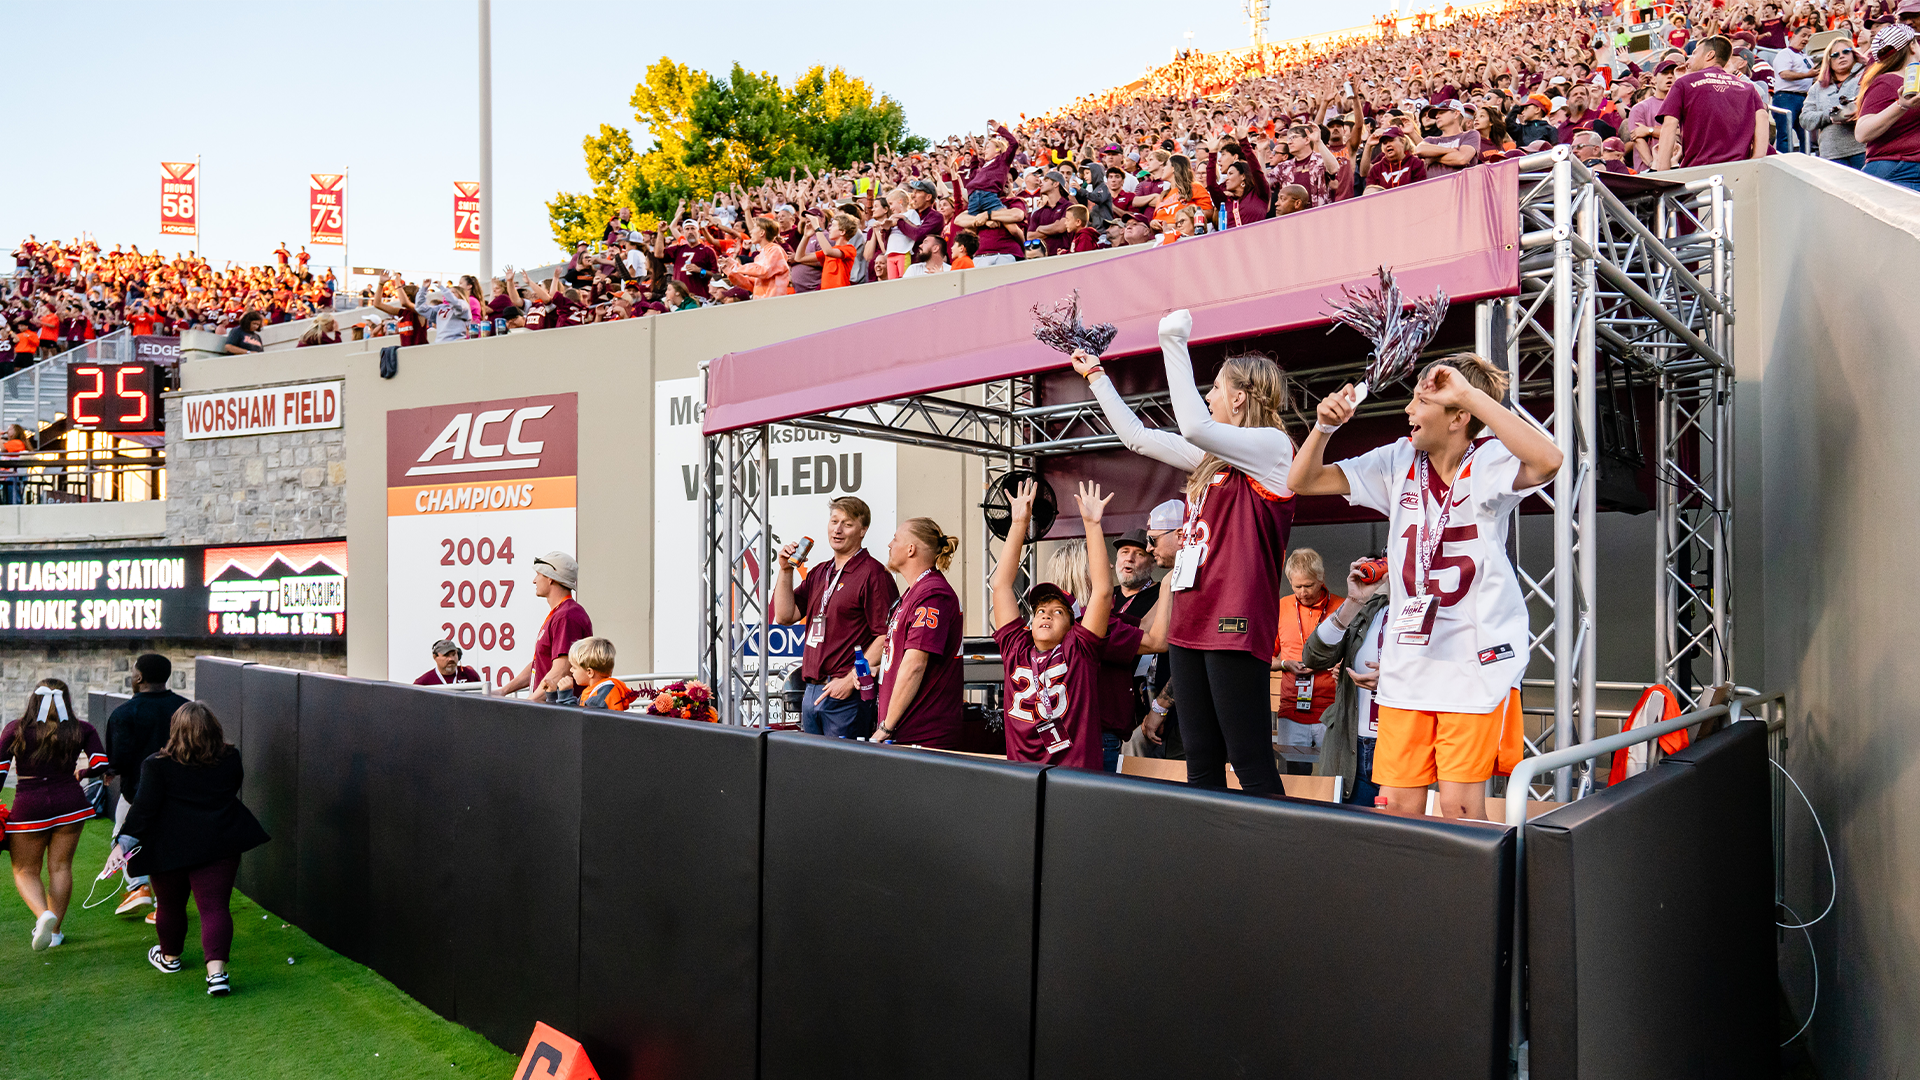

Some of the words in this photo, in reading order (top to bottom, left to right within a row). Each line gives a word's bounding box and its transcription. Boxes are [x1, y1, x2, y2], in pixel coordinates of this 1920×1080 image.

[1690, 78, 1727, 88] VIRGINIA
[1728, 80, 1745, 89] TECH
[164, 183, 192, 194] BROWN
[1381, 167, 1410, 183] VT
[162, 194, 194, 218] 58
[312, 204, 342, 229] 73
[1164, 204, 1179, 215] VT
[163, 225, 195, 234] HOKIES
[456, 211, 480, 235] 78
[313, 236, 342, 244] HOKIES
[144, 344, 180, 356] EDGE
[73, 367, 147, 423] 25
[187, 394, 276, 433] WORSHAM
[284, 389, 336, 425] FIELD
[417, 405, 555, 462] ACC
[415, 484, 534, 513] CHAMPIONS
[440, 536, 515, 566] 2004
[7, 559, 103, 591] FLAGSHIP
[107, 557, 186, 590] STATION
[1401, 523, 1479, 608] 15
[208, 579, 280, 612] ESPN
[284, 582, 341, 607] BLACKSBURG
[440, 580, 515, 609] 2007
[15, 599, 77, 630] HOKIE
[80, 598, 162, 630] SPORTS!
[912, 607, 939, 629] 25
[441, 622, 515, 651] 2008
[1008, 661, 1069, 723] 25
